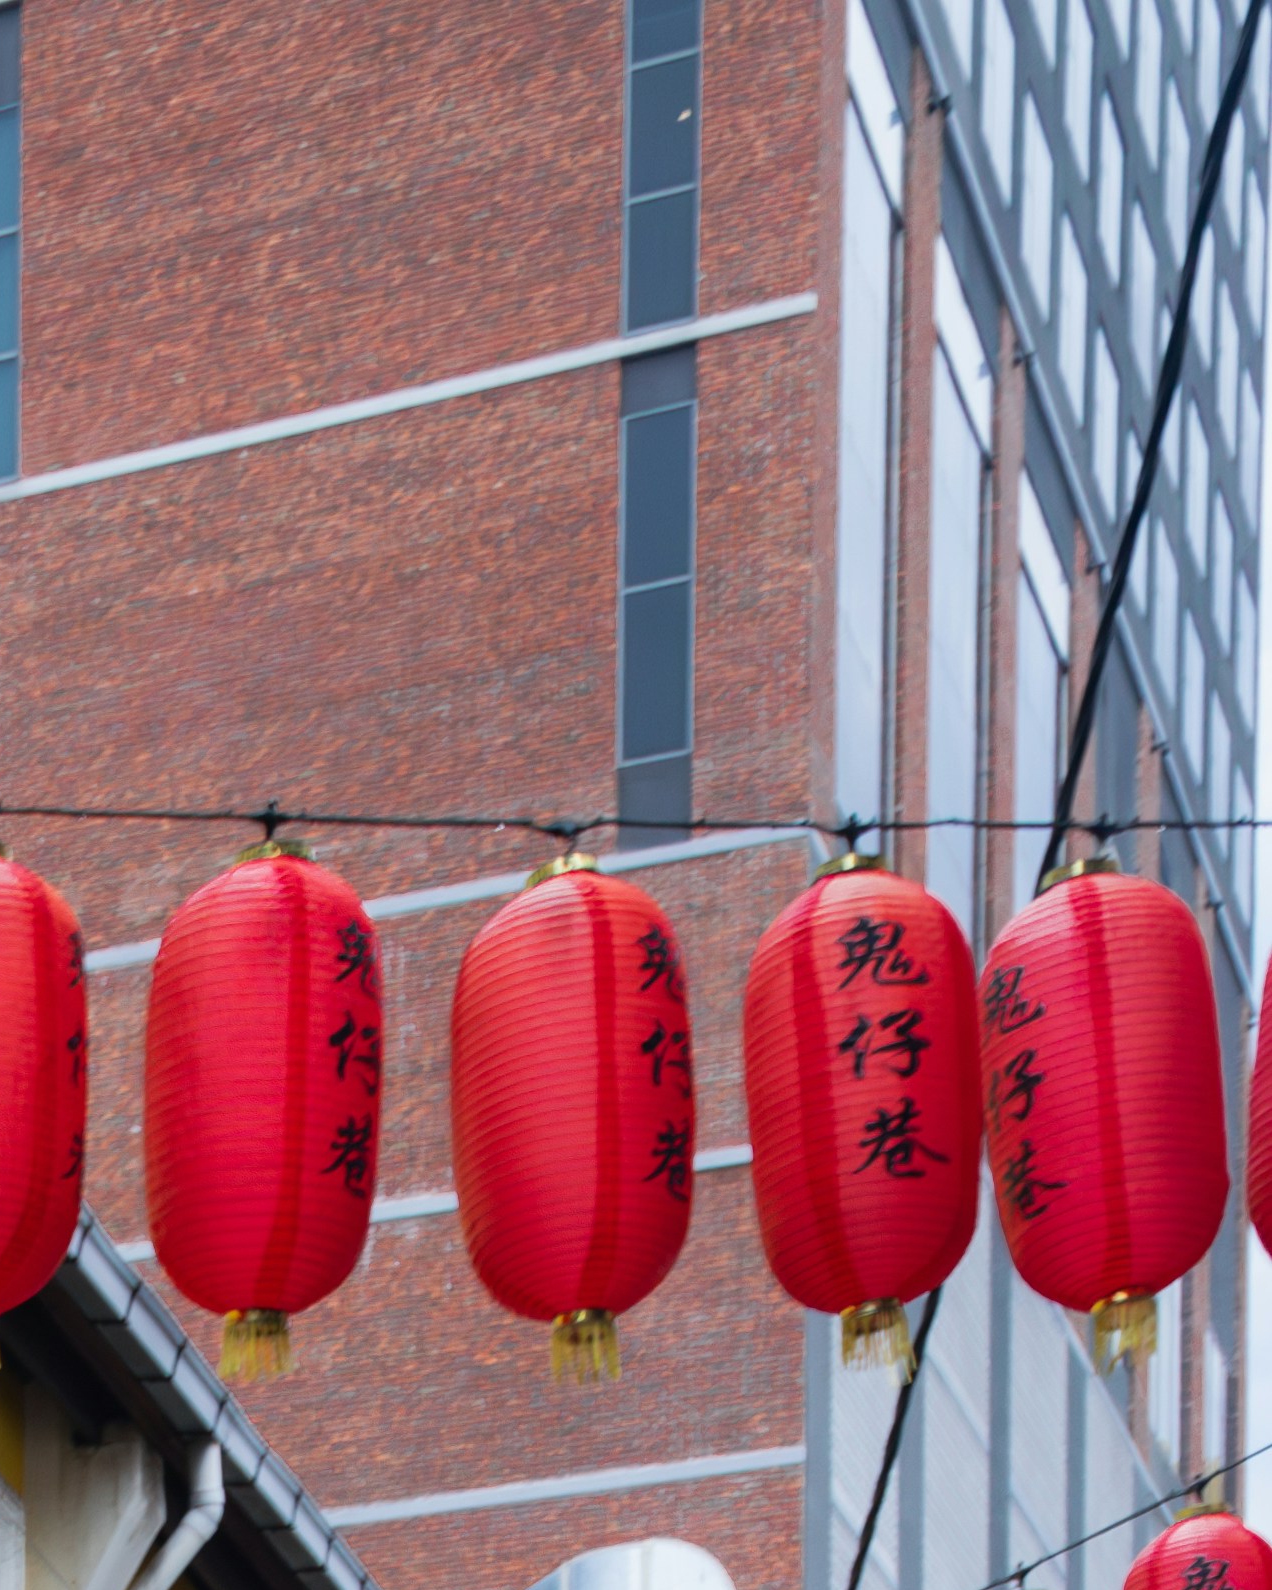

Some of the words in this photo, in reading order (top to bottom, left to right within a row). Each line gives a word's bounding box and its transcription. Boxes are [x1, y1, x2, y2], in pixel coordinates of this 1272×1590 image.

[838, 915, 948, 1180] 鬼仔巷
[980, 962, 1067, 1222] 鬼仔巷
